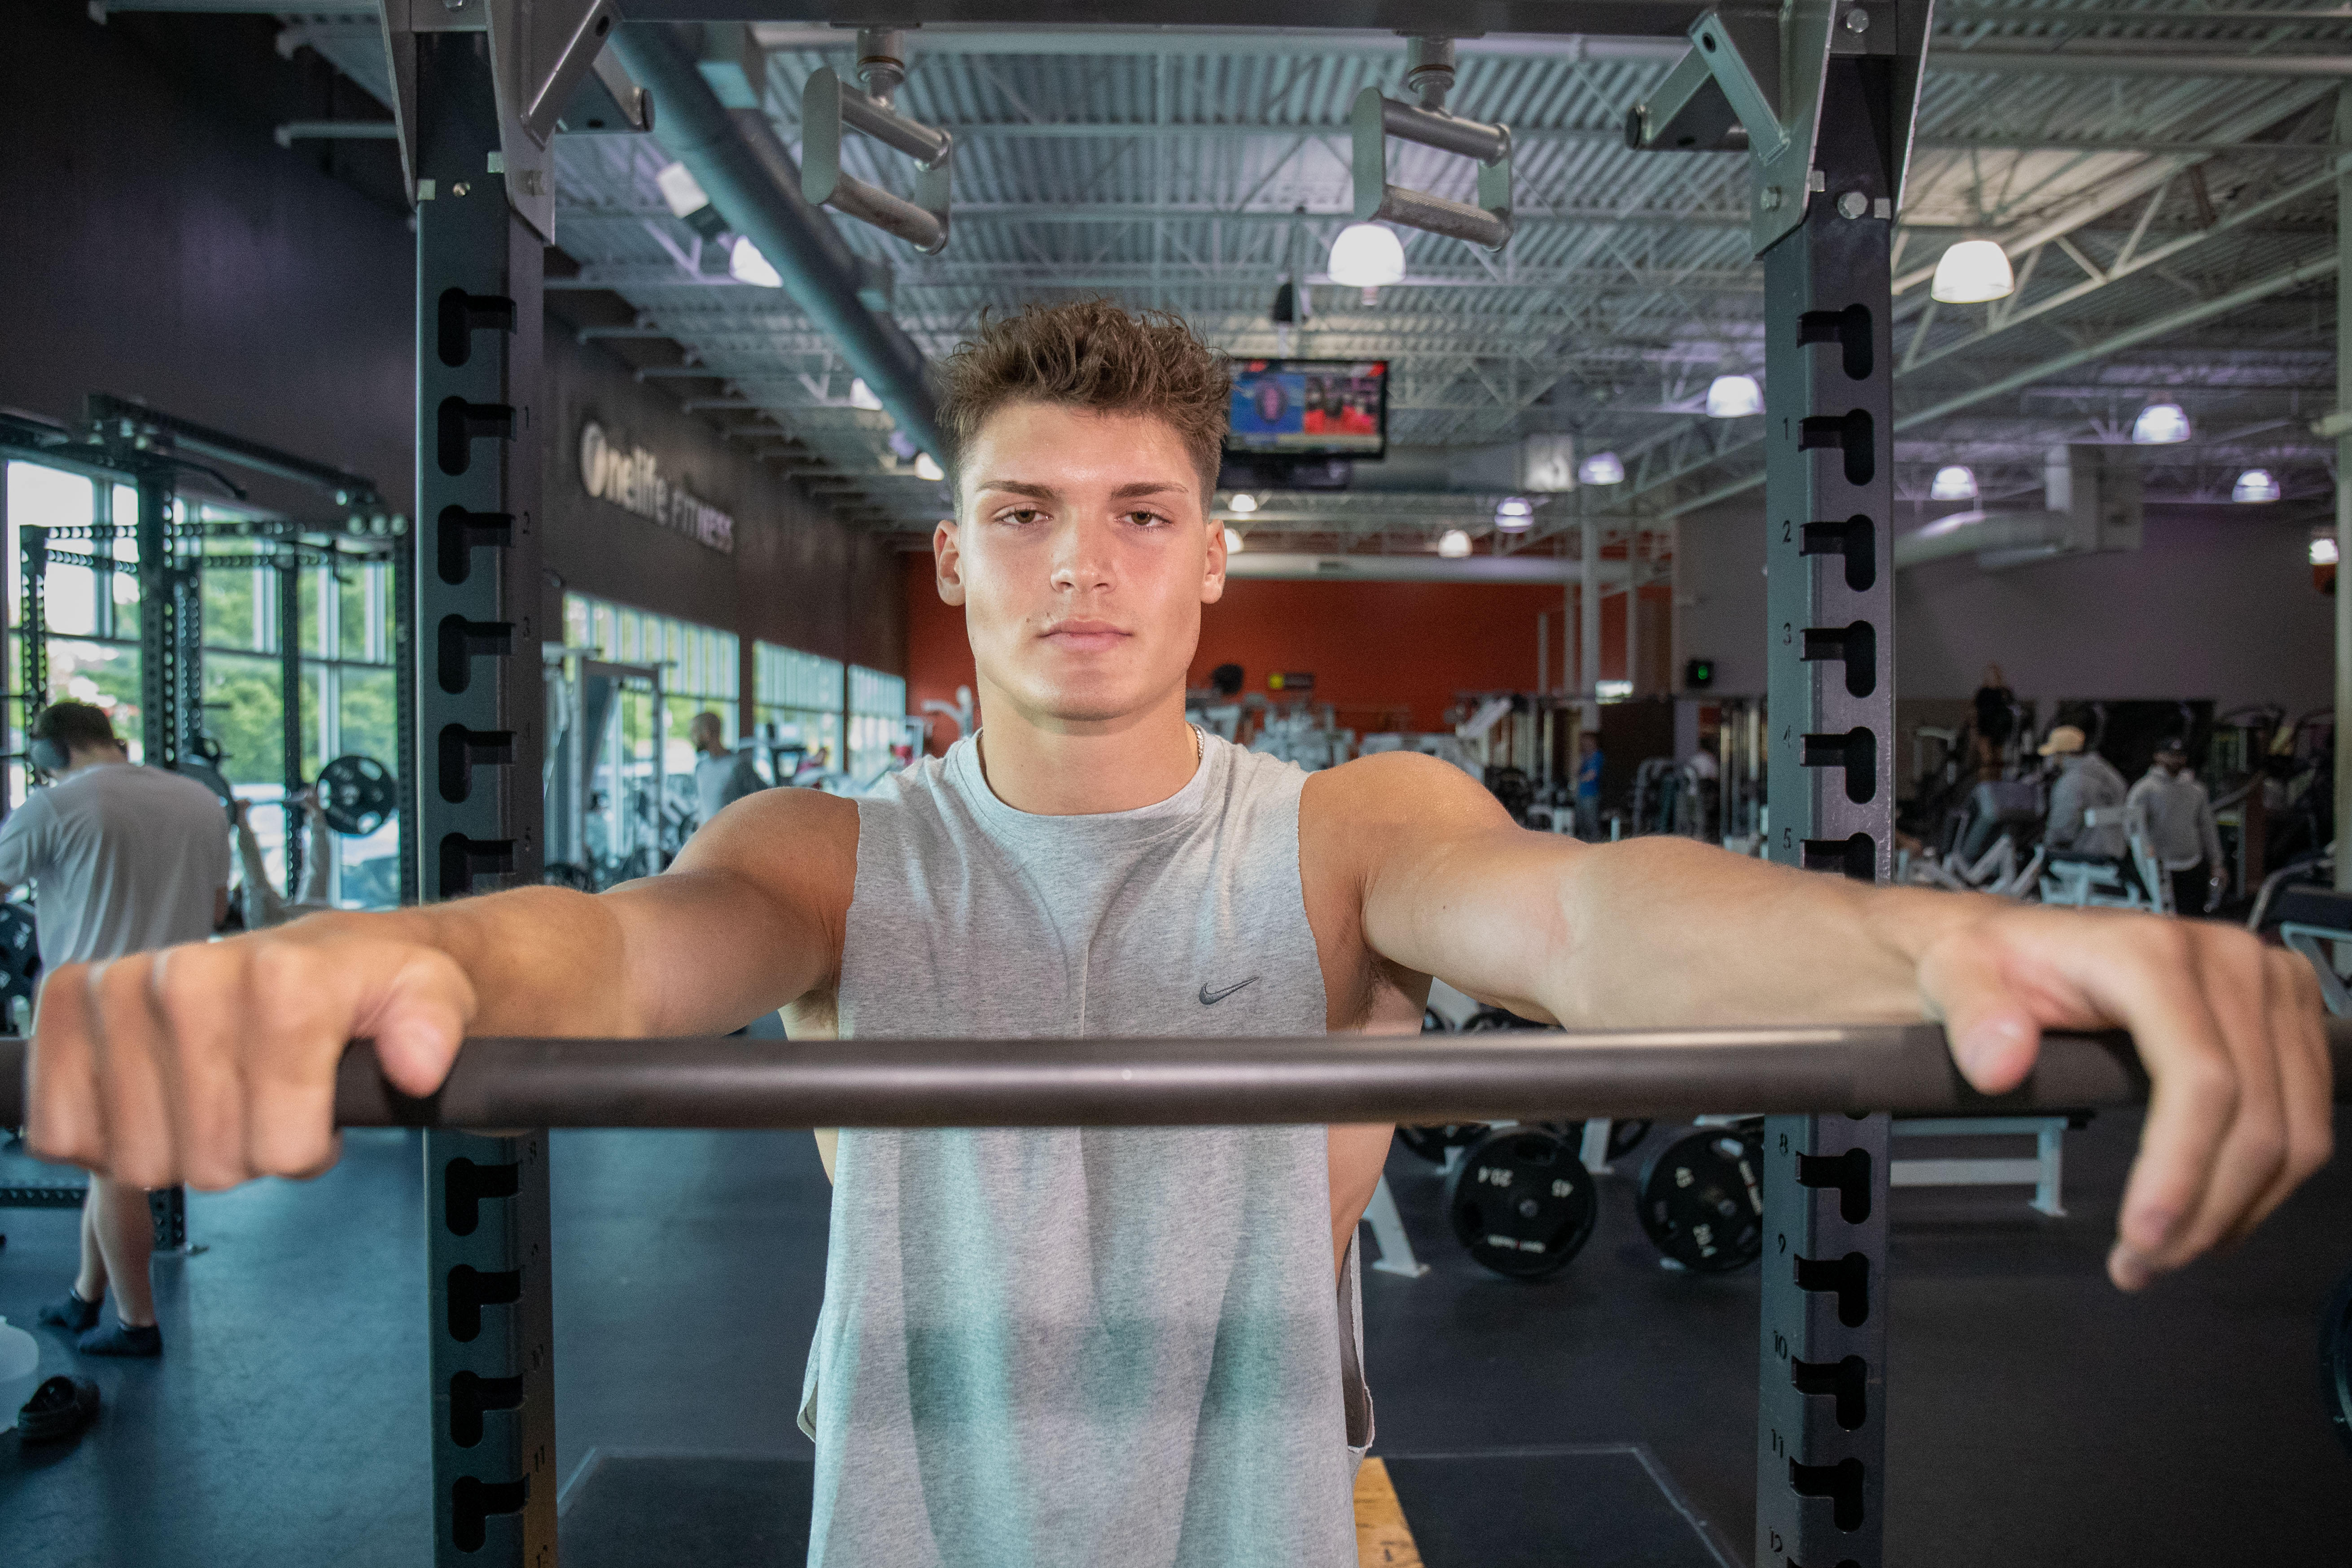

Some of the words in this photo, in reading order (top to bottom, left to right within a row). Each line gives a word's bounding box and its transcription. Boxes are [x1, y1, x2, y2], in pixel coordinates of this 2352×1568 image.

[1783, 417, 1788, 440] 1
[1783, 520, 1791, 543] 2
[1783, 622, 1791, 645] 3
[1783, 828, 1791, 851] 5
[1779, 1133, 1788, 1156] 8
[1774, 1330, 1787, 1360] 10
[1772, 1429, 1783, 1459] 11
